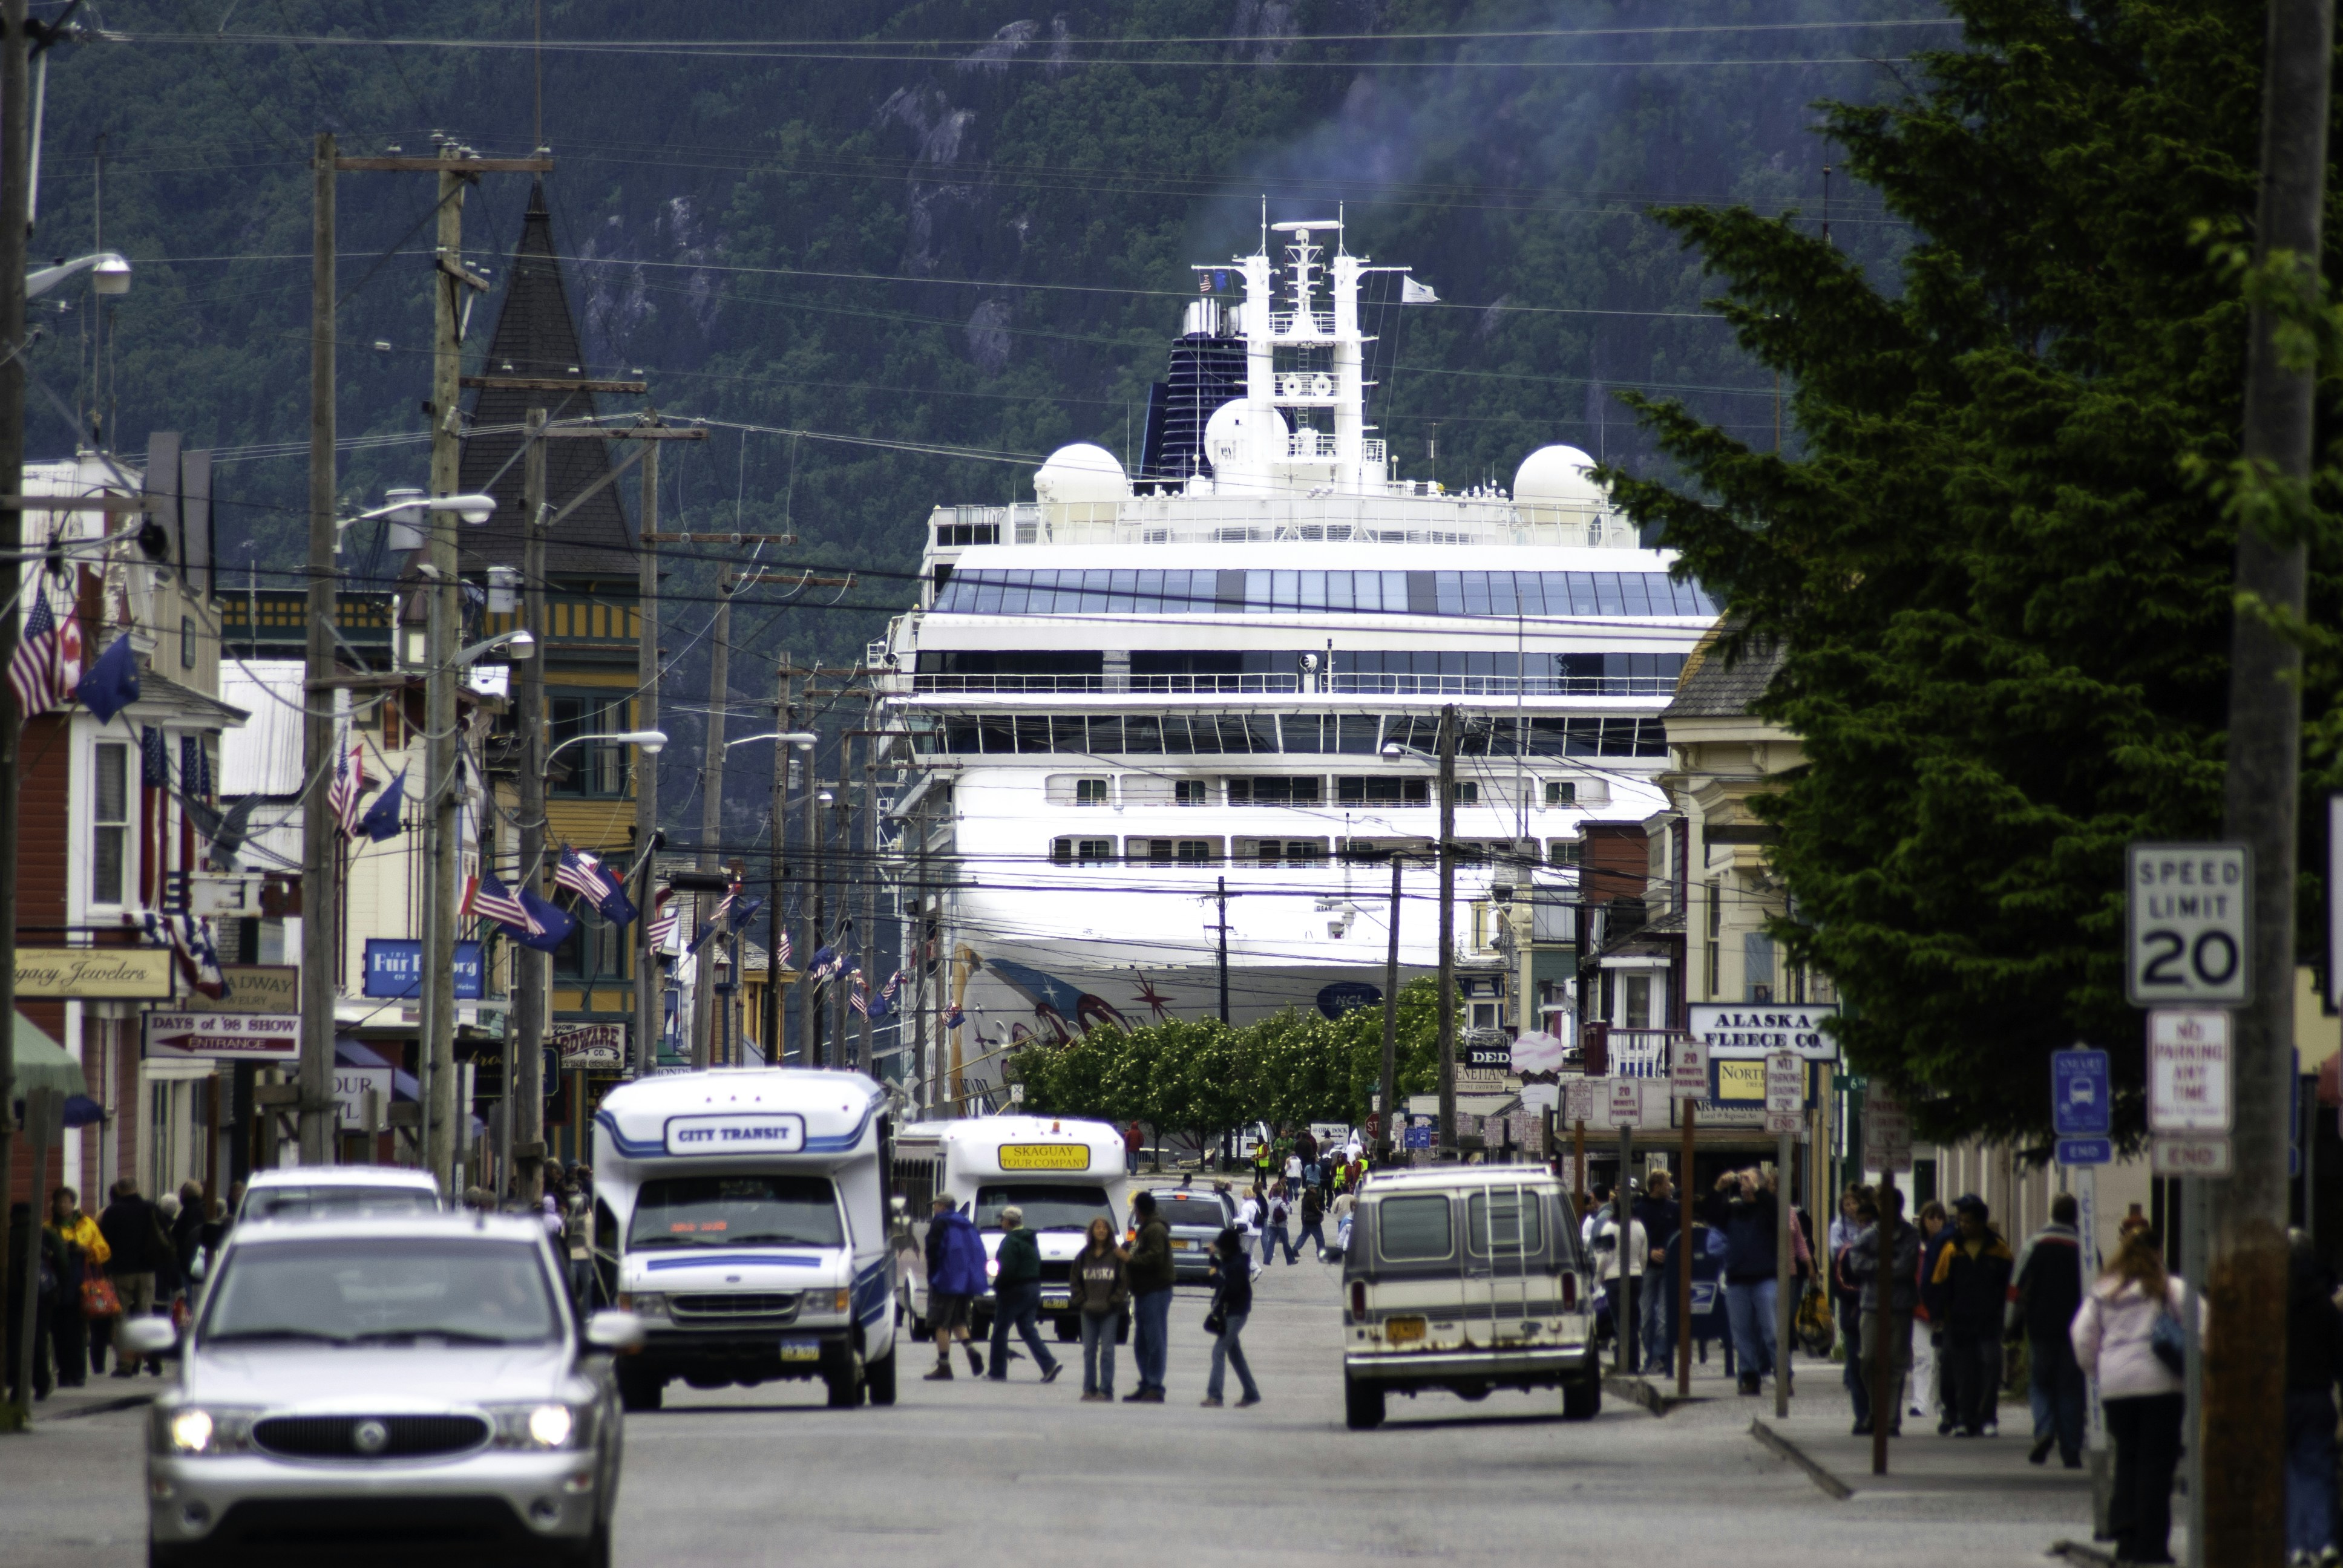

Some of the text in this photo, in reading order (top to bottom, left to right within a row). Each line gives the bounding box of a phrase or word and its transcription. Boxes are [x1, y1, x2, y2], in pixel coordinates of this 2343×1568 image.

[2139, 860, 2240, 886] SPEED
[2149, 893, 2229, 920] LIMIT
[373, 953, 409, 972] Fur
[2142, 929, 2239, 986] 20
[15, 961, 149, 987] gacy Jewelers
[1335, 995, 1365, 1005] NCL
[152, 1017, 195, 1029] DAYS
[200, 1018, 216, 1030] of
[248, 1019, 298, 1032] SHOW
[1714, 1014, 1813, 1029] ALASKA
[2177, 1024, 2204, 1040] NO
[188, 1037, 267, 1050] ENTRANCE
[1704, 1033, 1787, 1048] FLEECE
[1684, 1052, 1698, 1064] 20
[2154, 1044, 2223, 1060] PARKING
[1777, 1059, 1793, 1071] NO
[1618, 1086, 1631, 1096] 20
[1674, 1079, 1705, 1088] PARKING
[1367, 1121, 1378, 1132] ST
[1773, 1117, 1796, 1129] END
[678, 1127, 789, 1142] CITY TRANSIT
[1014, 1146, 1074, 1157] SKAGUAY
[2068, 1145, 2100, 1158] END
[2168, 1147, 2216, 1166] END
[1001, 1158, 1087, 1168] TOUR COMPANY
